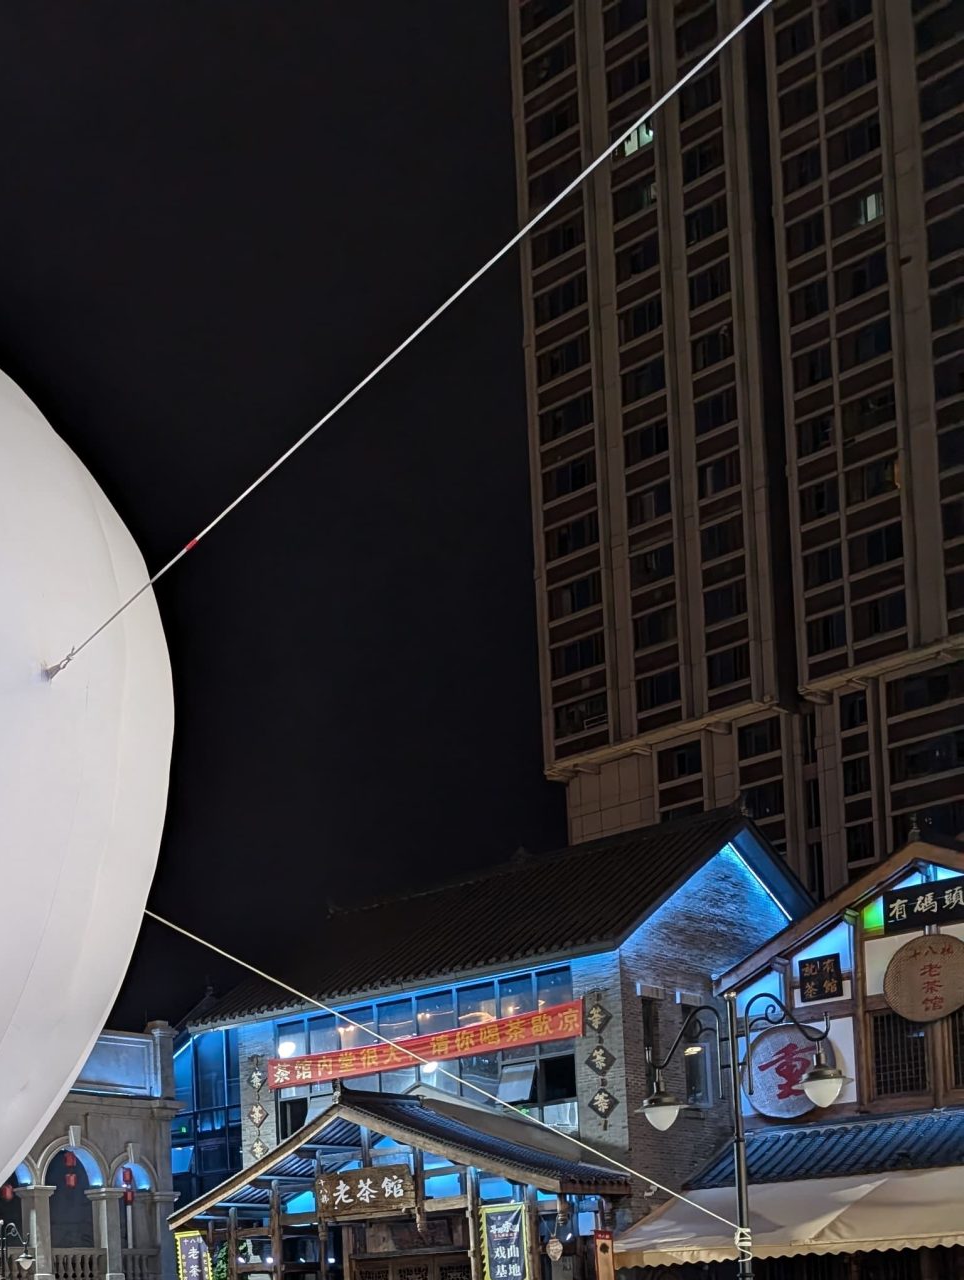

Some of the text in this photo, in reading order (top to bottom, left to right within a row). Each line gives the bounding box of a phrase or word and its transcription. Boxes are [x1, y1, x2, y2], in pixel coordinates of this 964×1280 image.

[889, 885, 964, 921] 有碼頭
[494, 1244, 520, 1259] 戏曲
[496, 1263, 522, 1278] 基地
